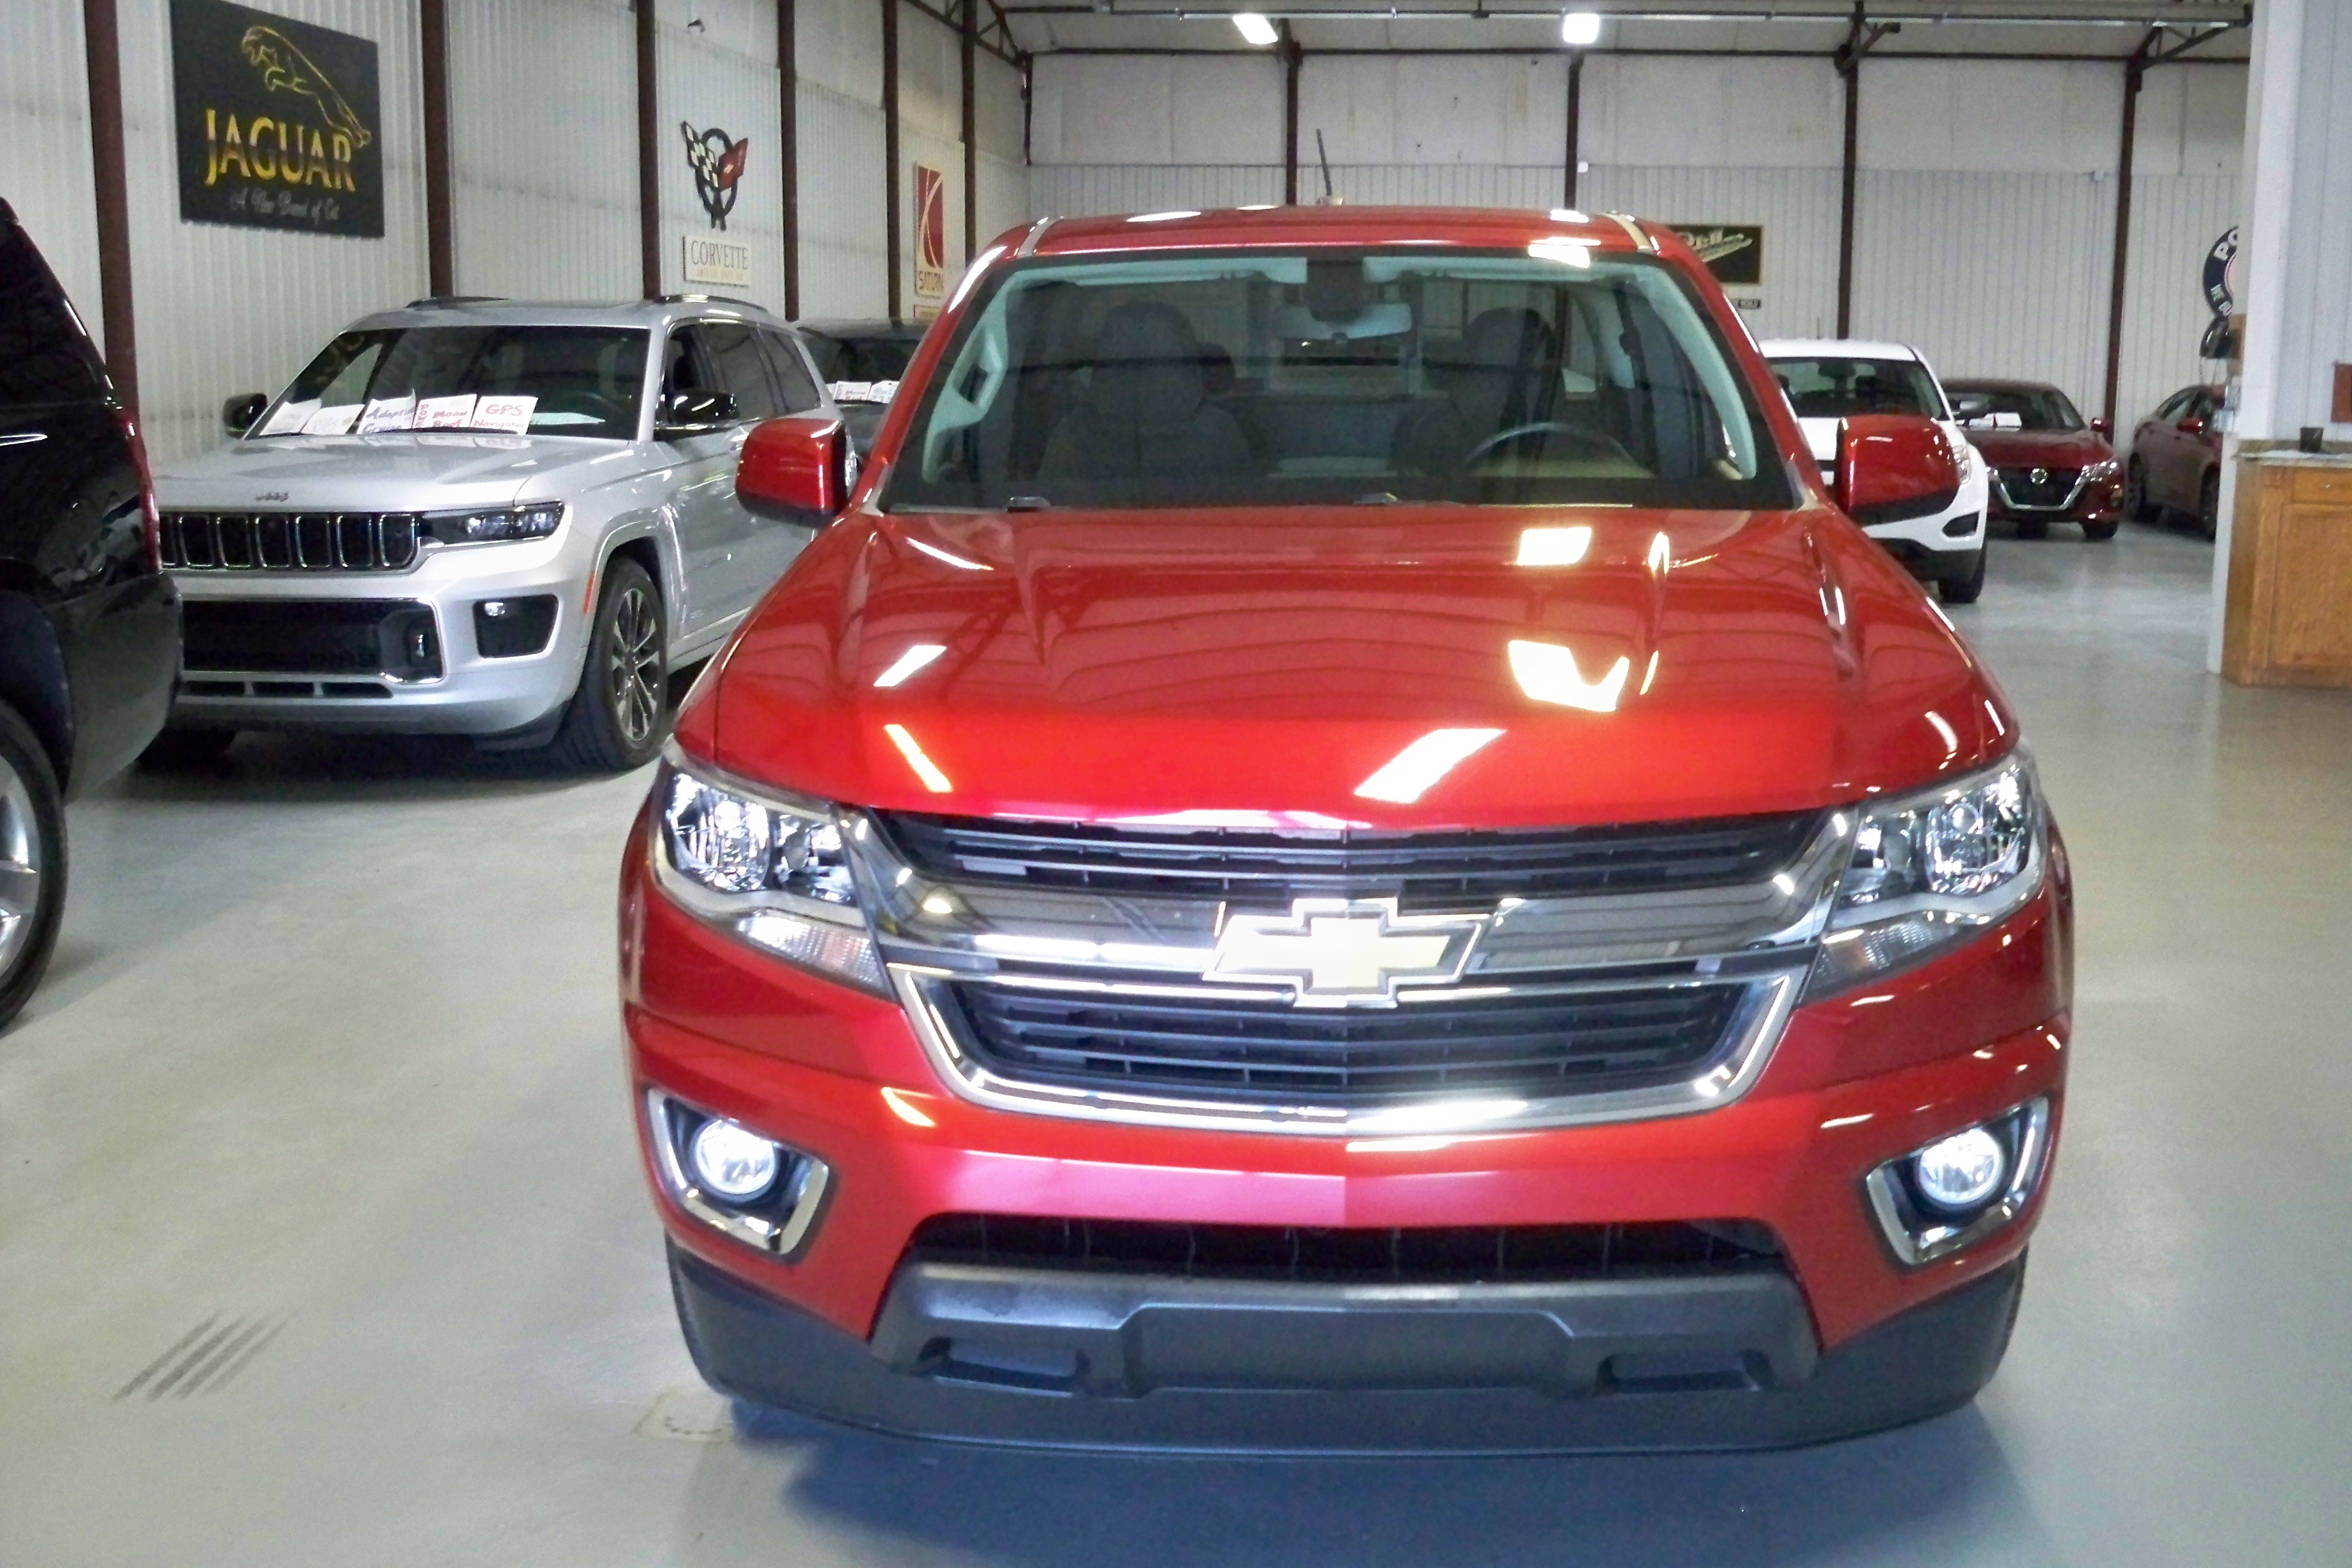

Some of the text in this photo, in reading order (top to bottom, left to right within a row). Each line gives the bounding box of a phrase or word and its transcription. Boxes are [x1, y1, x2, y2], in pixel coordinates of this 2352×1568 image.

[205, 109, 356, 192] JAGUAR
[691, 240, 748, 270] CORVETTE
[485, 404, 524, 416] GPS
